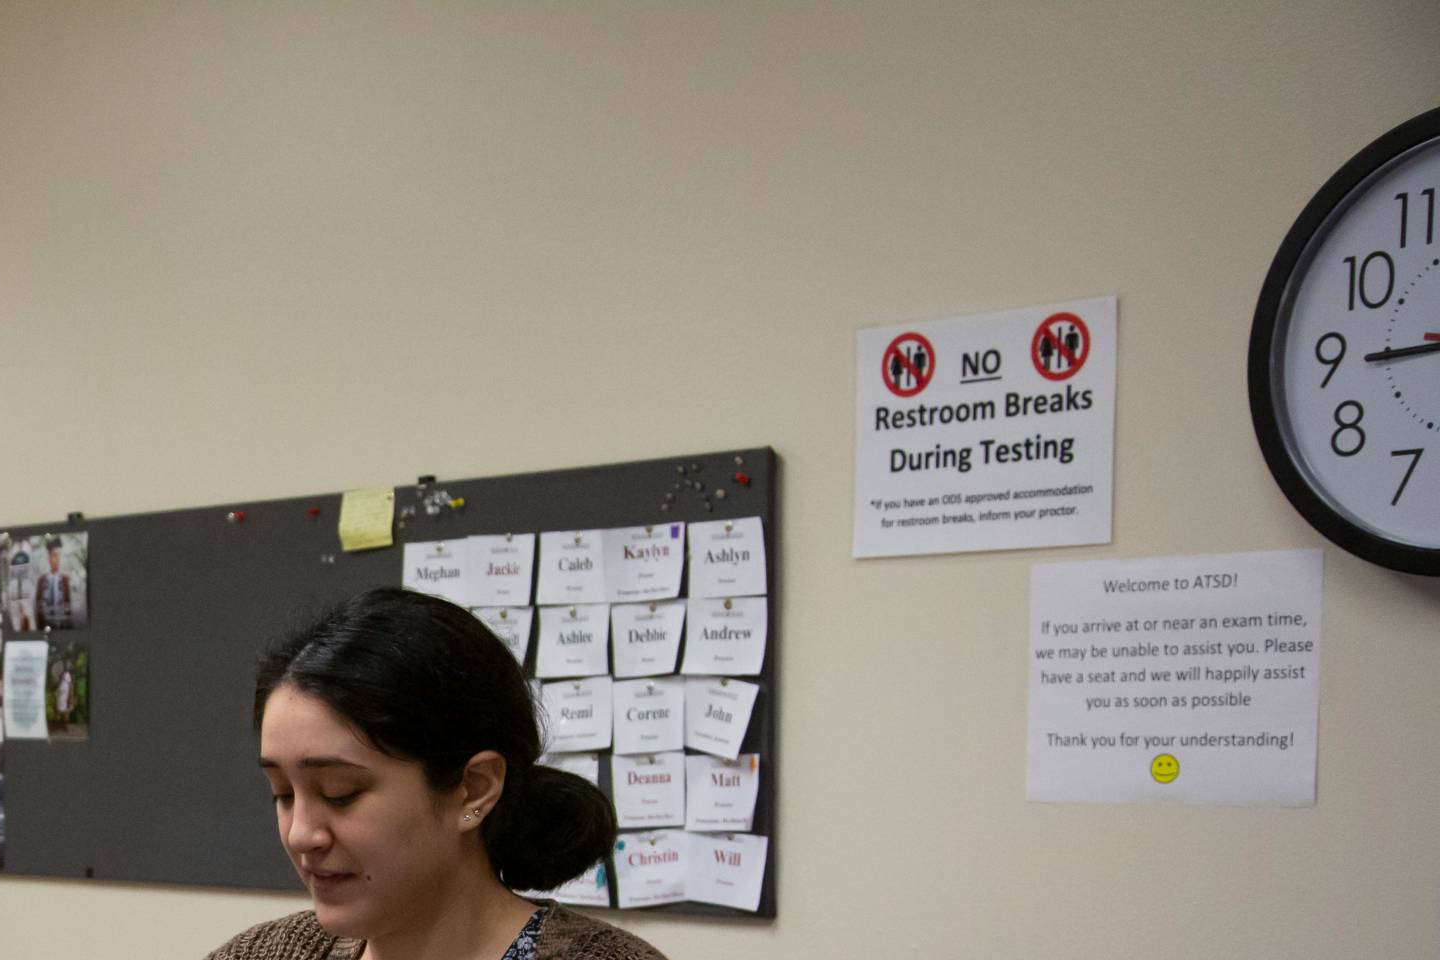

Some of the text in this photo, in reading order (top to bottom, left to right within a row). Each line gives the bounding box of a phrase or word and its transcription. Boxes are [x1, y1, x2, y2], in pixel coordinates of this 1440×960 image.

[1394, 187, 1436, 249] 11
[1343, 250, 1396, 312] 10
[961, 348, 1002, 378] NO
[1314, 331, 1347, 389] 9
[874, 385, 1093, 432] Restroom Breaks
[1330, 399, 1366, 458] 8
[889, 434, 1075, 474] During Testing
[1389, 448, 1425, 507] 7
[884, 500, 901, 511] you
[903, 497, 925, 508] have
[927, 497, 940, 506] an
[964, 490, 1010, 505] approved
[1013, 485, 1094, 500] accommodation
[881, 517, 894, 528] for
[896, 516, 940, 527] restroom
[979, 510, 1011, 521] inform
[1014, 509, 1037, 522] your
[557, 557, 594, 572] Caleb
[703, 547, 751, 566] Ashlyn
[1103, 572, 1238, 595] Welcome to ATSD!
[699, 625, 753, 641] Andrew
[1041, 611, 1307, 637] If you arrive at or near an exam time,
[1035, 637, 1314, 661] we may be unable to assist you. Please
[1041, 664, 1306, 684] have a seat and we will happily assist
[1086, 692, 1252, 711] you as soon as possible
[704, 703, 733, 725] John
[1047, 732, 1295, 750] Thank you for your understanding!
[627, 771, 673, 786] Deanna
[711, 772, 742, 789] Matt
[627, 849, 679, 868] Christin
[714, 849, 742, 868] Will
